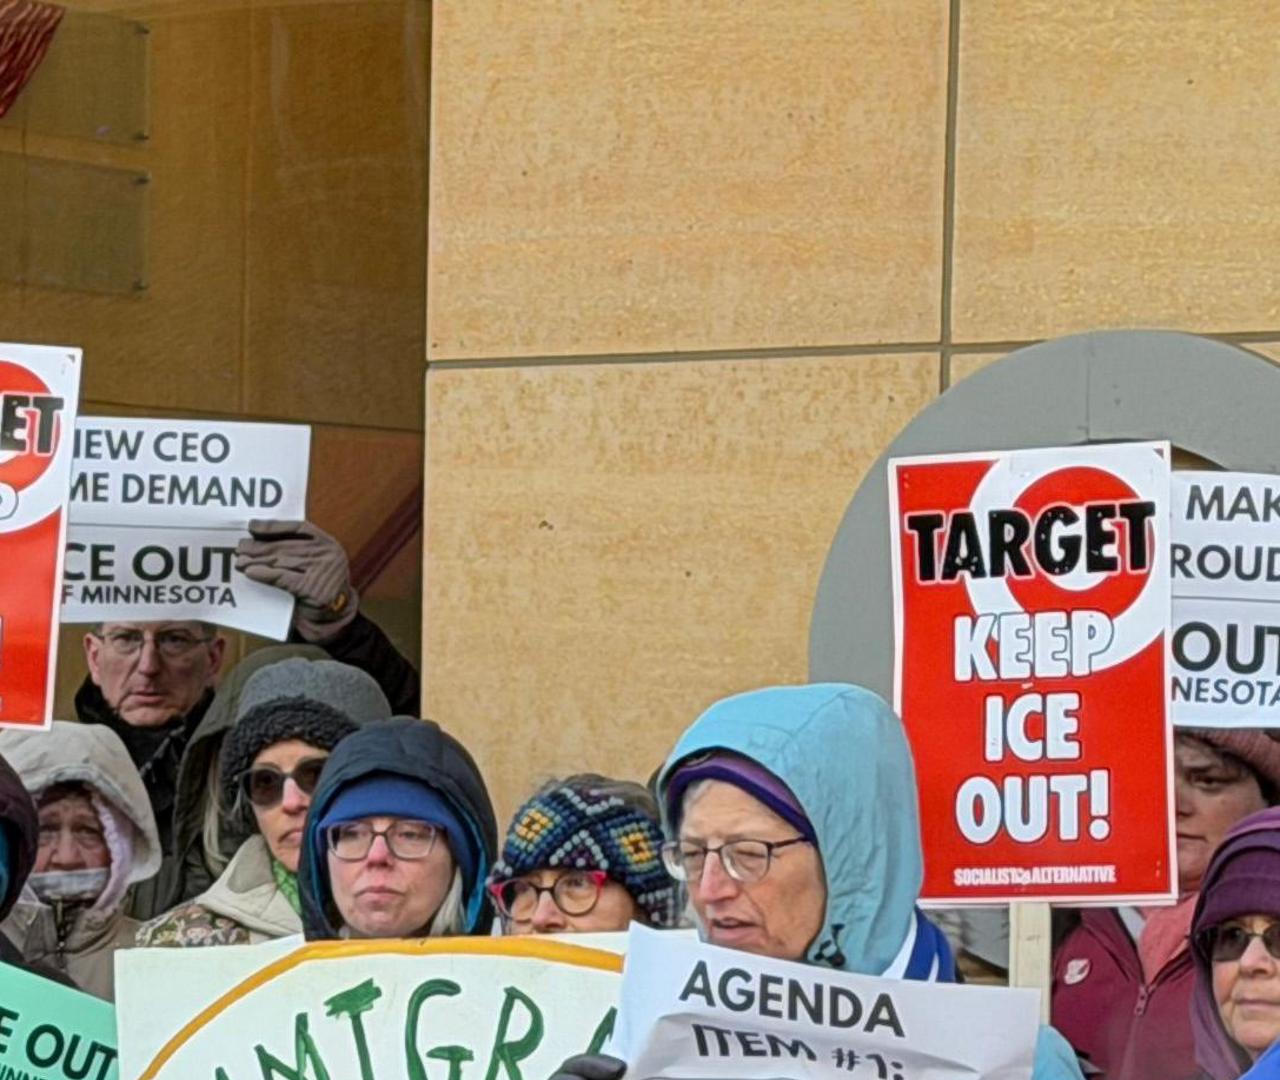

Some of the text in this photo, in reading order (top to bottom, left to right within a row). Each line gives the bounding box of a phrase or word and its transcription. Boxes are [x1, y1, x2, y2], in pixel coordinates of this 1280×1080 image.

[153, 431, 230, 463] CEO
[121, 474, 283, 508] DEMAND
[63, 543, 237, 583] CE OUT
[905, 502, 1156, 581] TARGET
[61, 585, 237, 608] F MINNESOTA
[954, 609, 1114, 682] KEEP
[985, 692, 1080, 762] ICE
[956, 768, 1112, 843] OUT!
[679, 960, 906, 1038] AGENDA
[692, 1024, 816, 1062] ITEM
